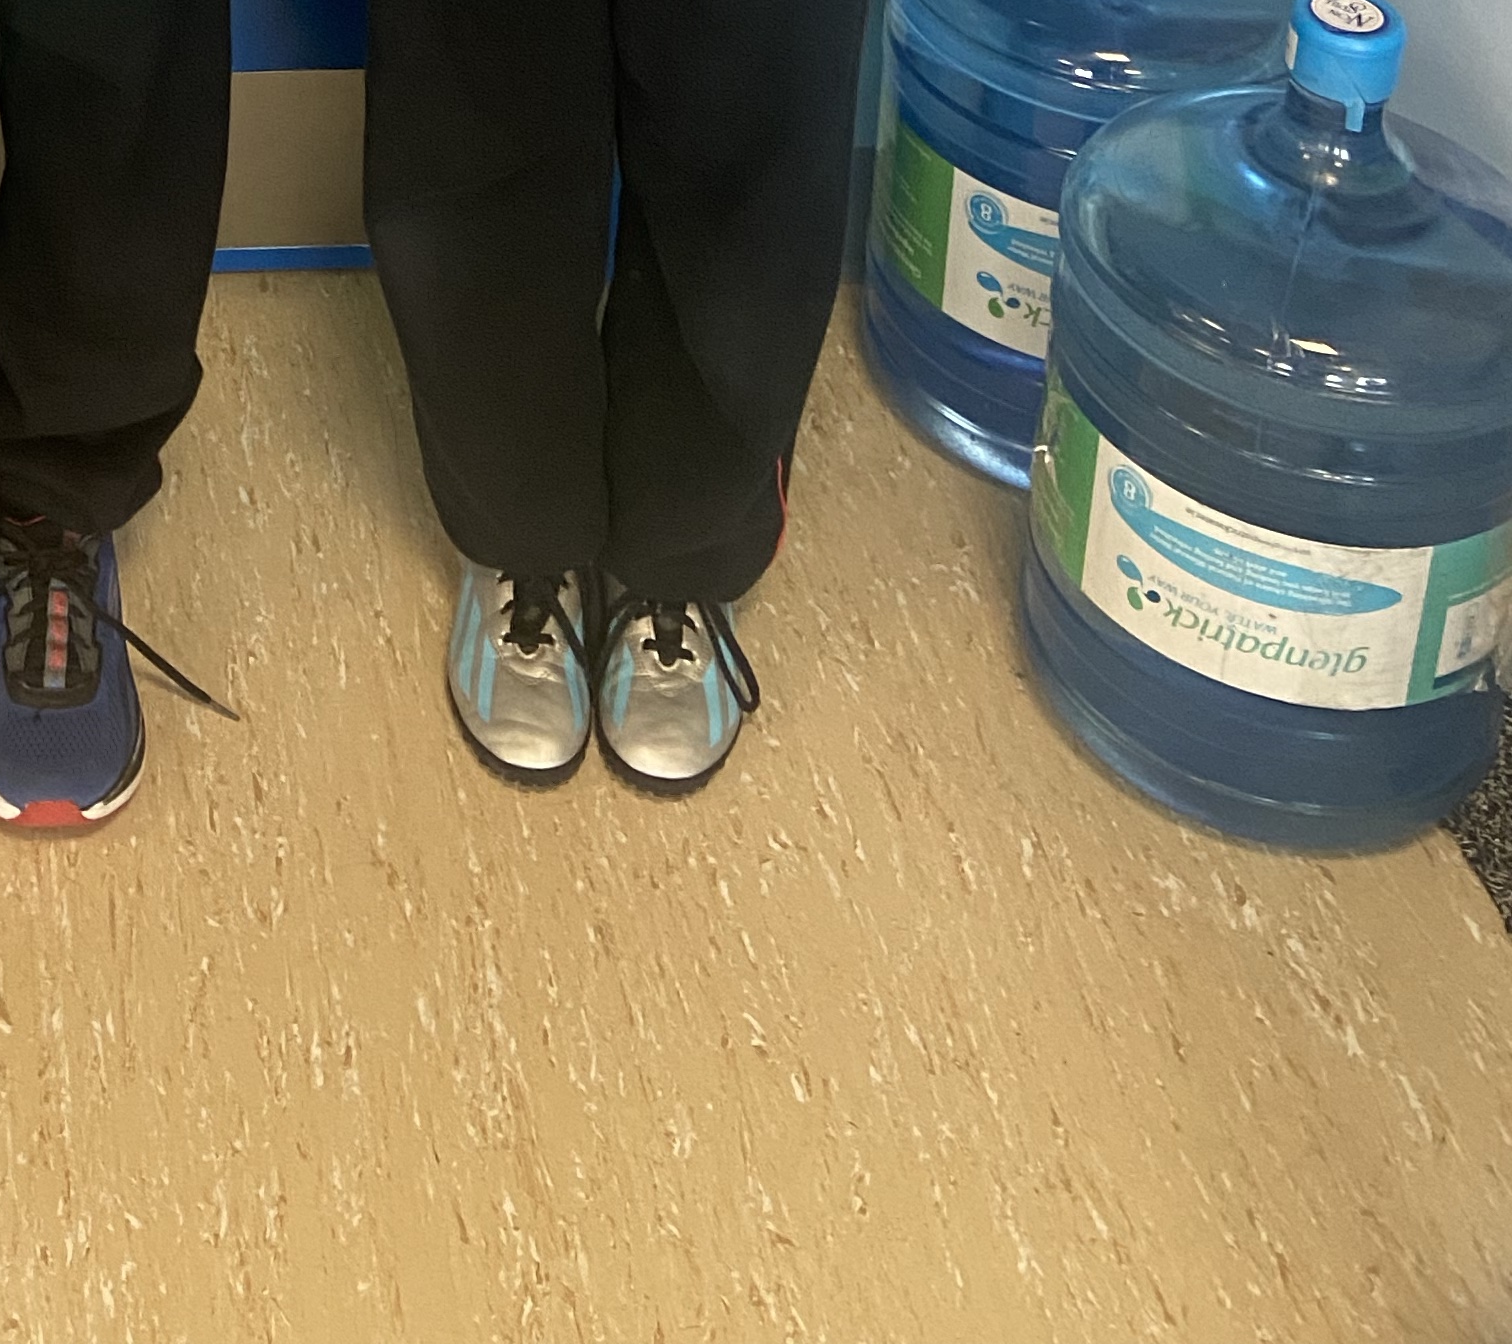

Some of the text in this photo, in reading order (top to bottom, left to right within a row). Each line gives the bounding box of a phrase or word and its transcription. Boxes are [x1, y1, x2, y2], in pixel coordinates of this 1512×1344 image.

[979, 202, 993, 222] 8
[1147, 573, 1178, 597] WAY
[1179, 590, 1220, 619] YOUR
[1162, 596, 1370, 677] glenpatrick
